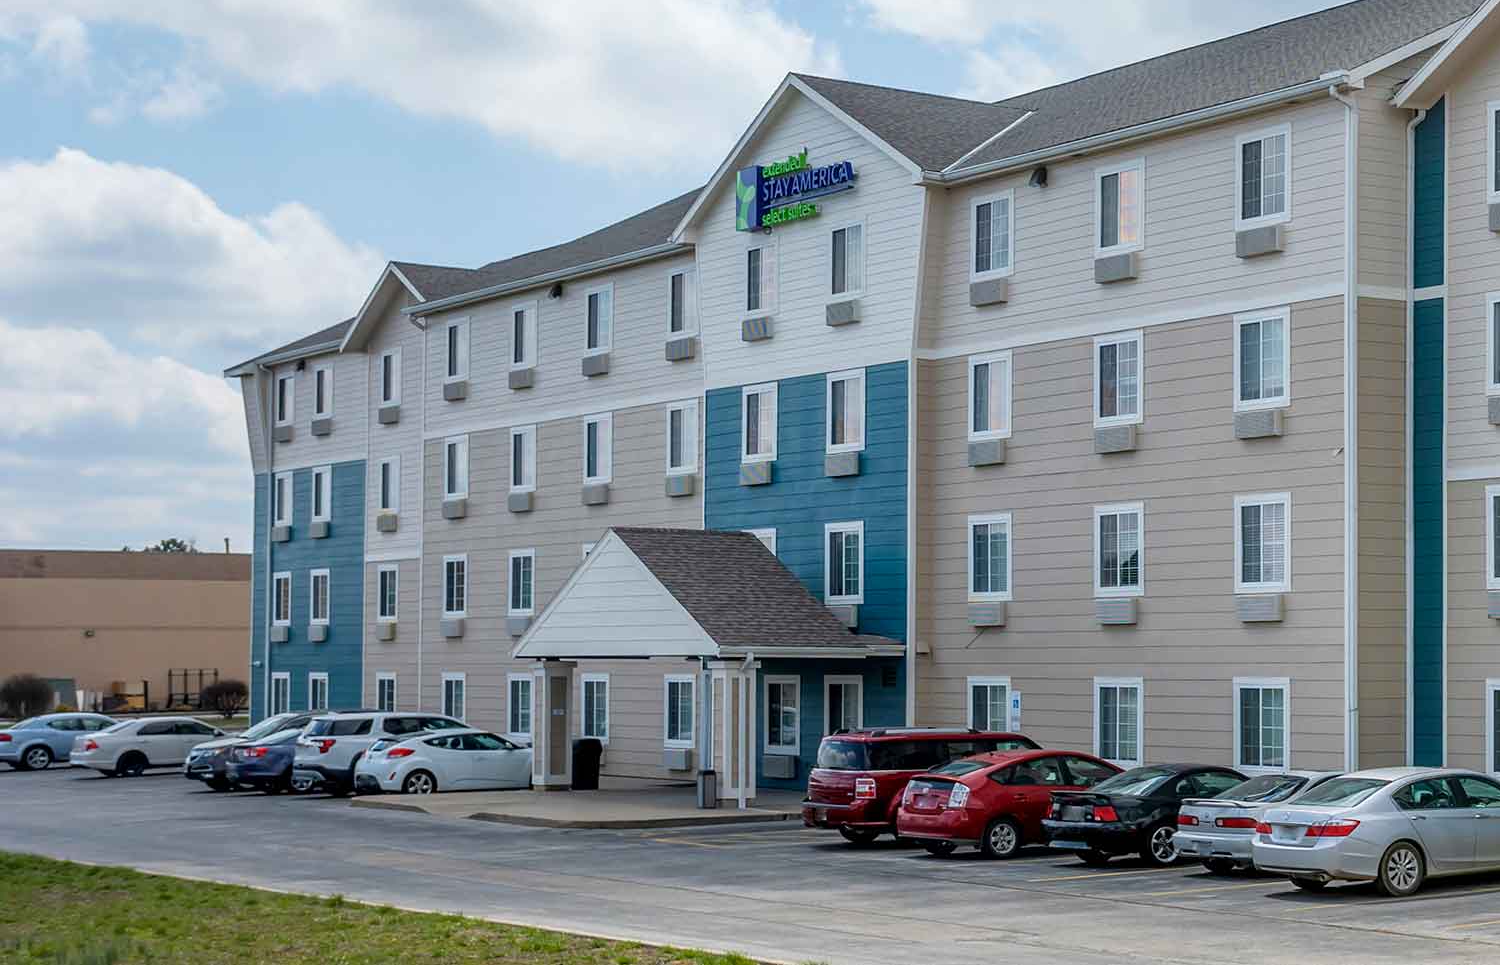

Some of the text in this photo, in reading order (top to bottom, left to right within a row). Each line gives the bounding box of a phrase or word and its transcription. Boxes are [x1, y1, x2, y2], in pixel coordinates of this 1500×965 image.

[762, 162, 852, 203] STAY AMERICA
[762, 206, 786, 226] select
